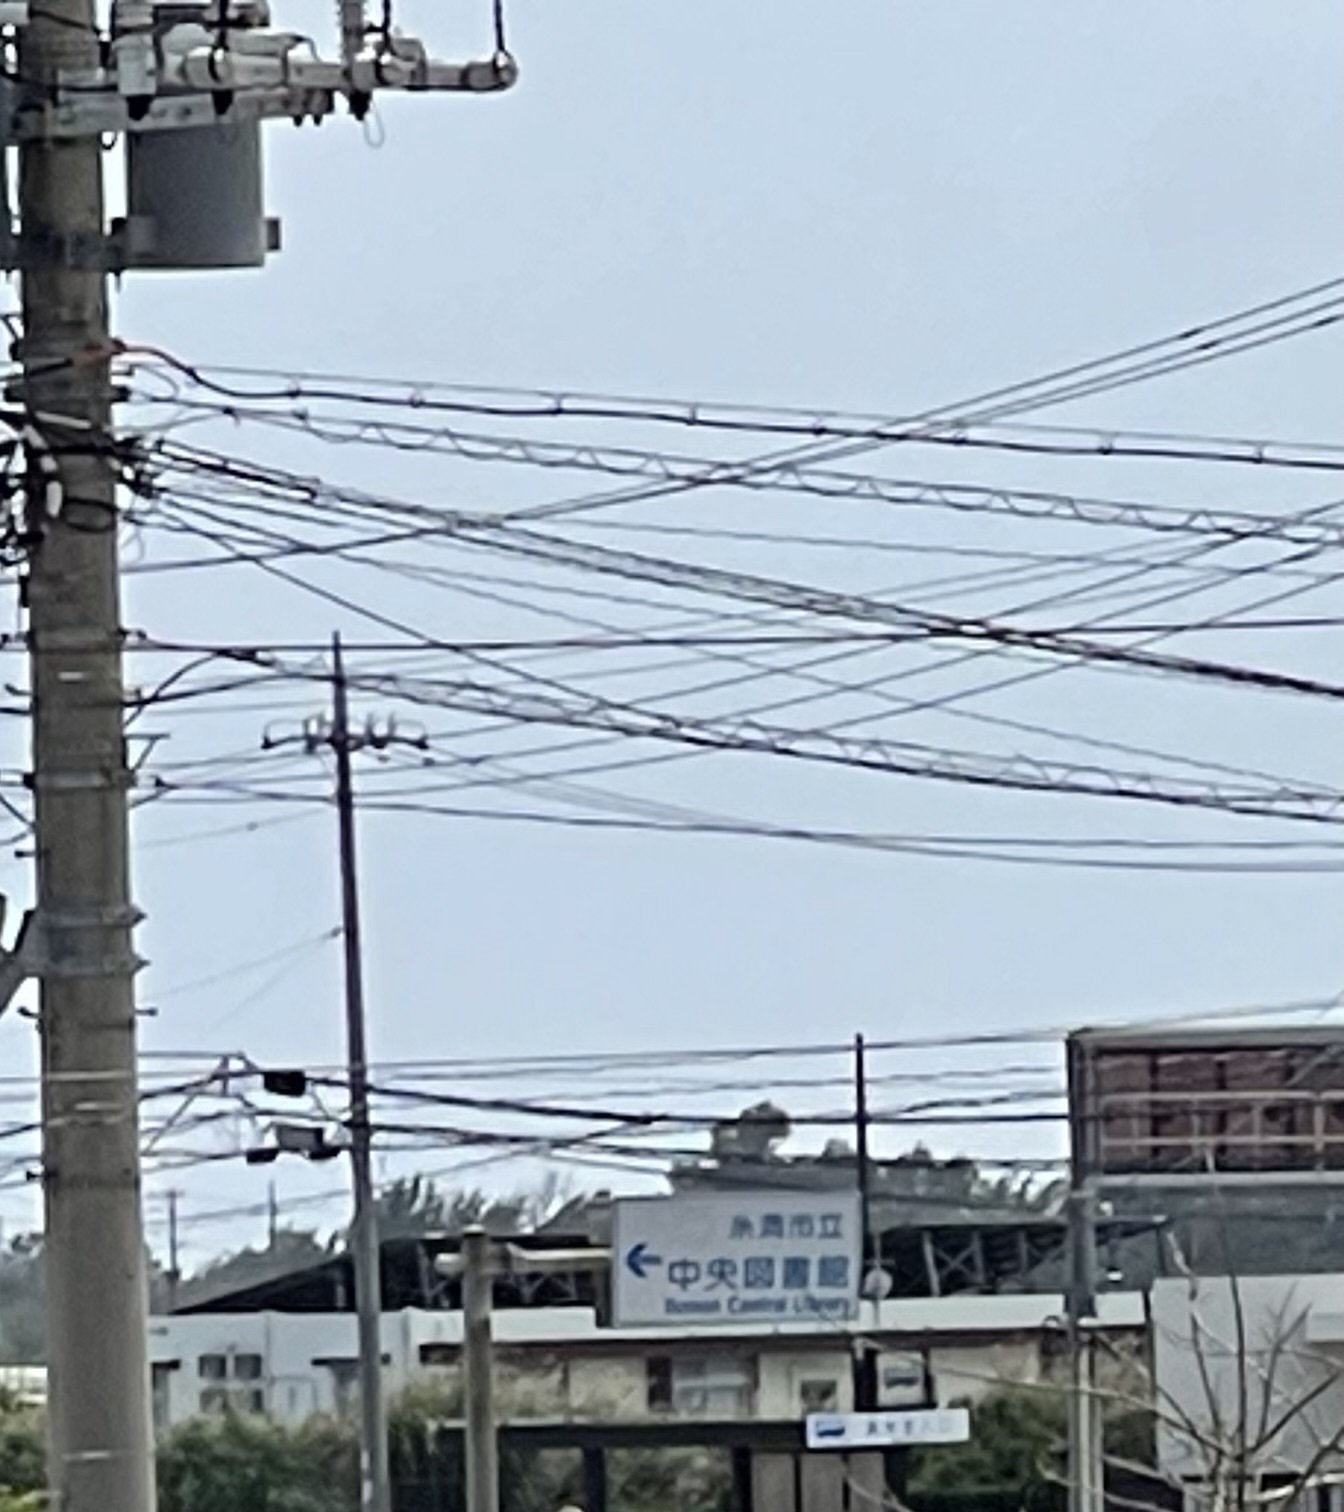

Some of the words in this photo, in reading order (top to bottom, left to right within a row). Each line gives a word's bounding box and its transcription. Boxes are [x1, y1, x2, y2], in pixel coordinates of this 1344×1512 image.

[667, 1256, 849, 1290] 中央図書館
